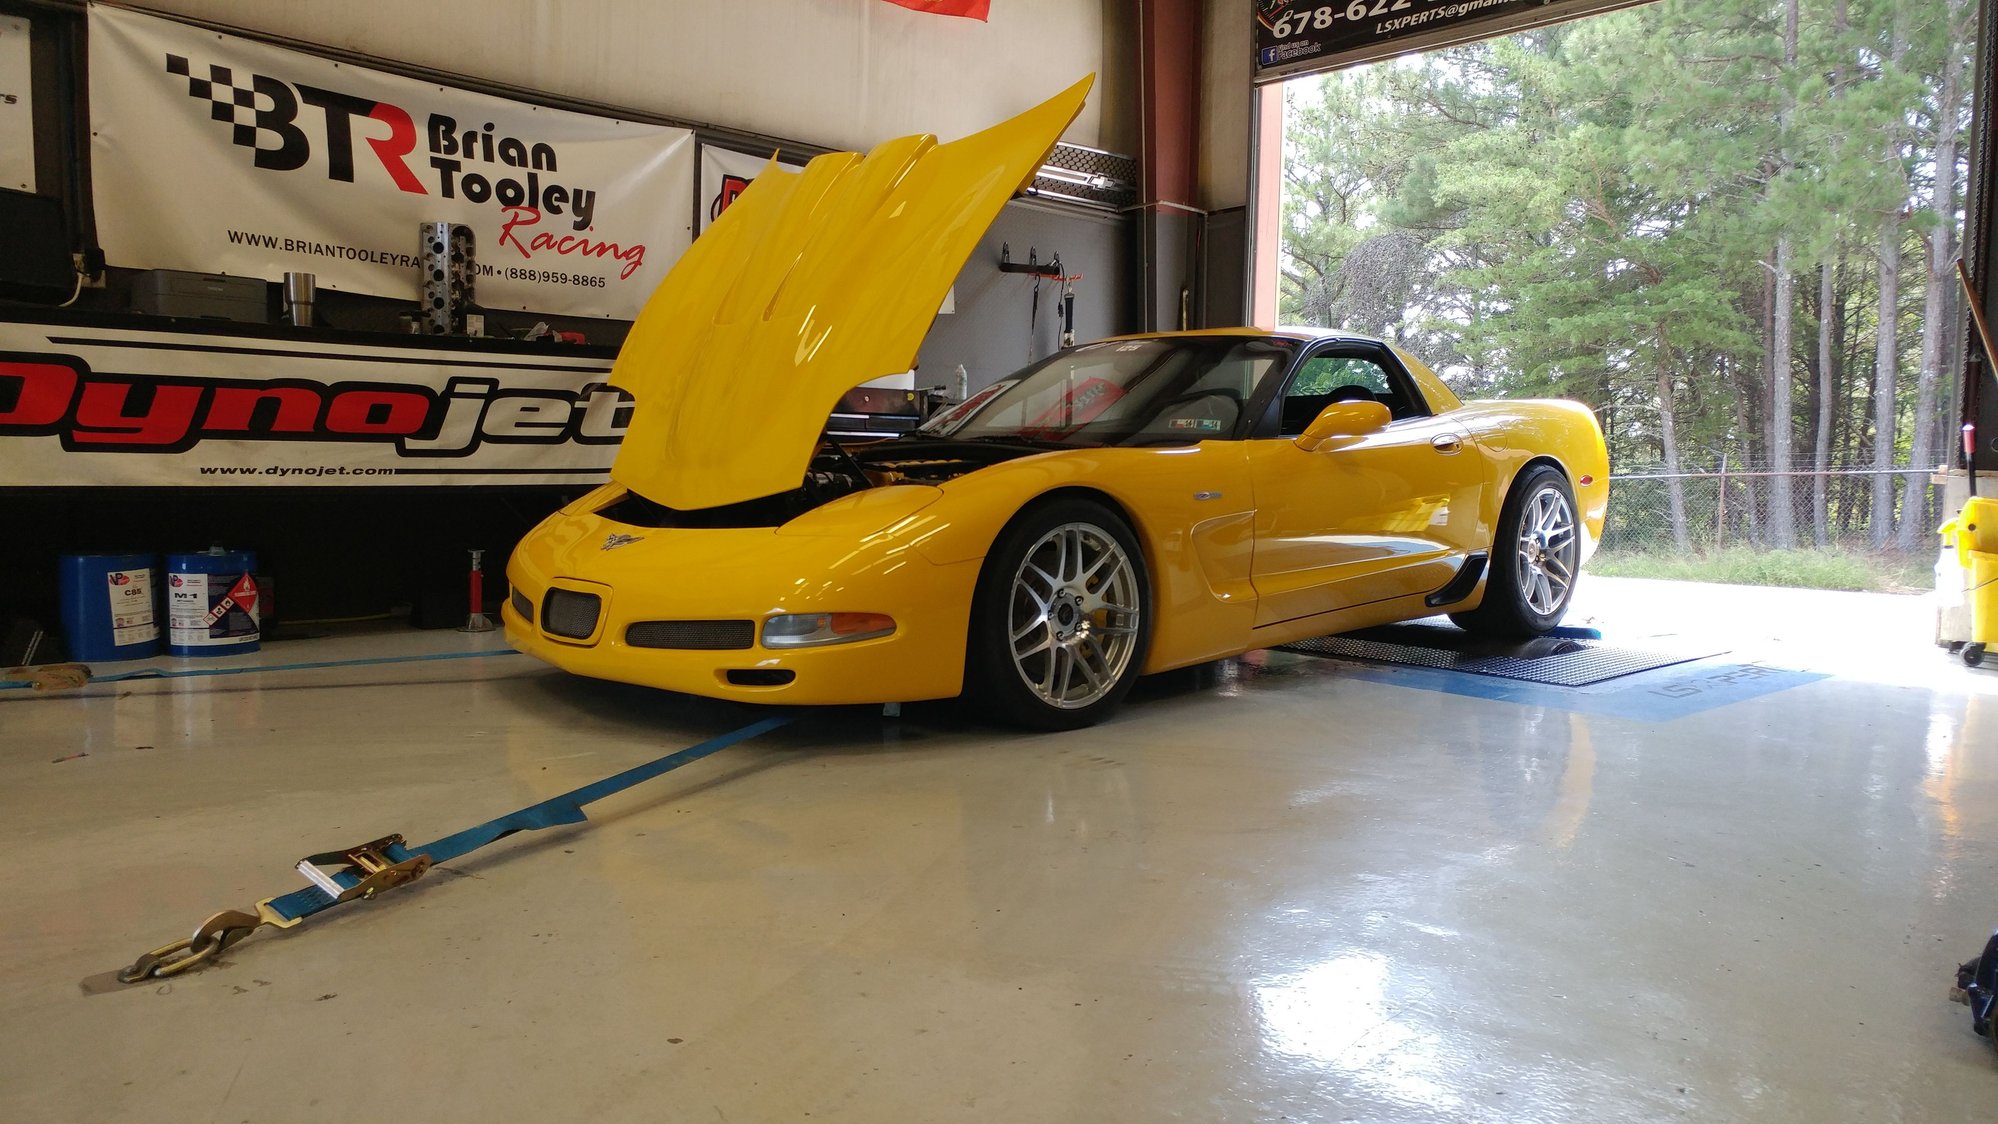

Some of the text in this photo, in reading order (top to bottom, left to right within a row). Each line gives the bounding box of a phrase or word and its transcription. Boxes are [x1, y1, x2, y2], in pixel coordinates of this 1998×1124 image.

[252, 74, 428, 195] BTR
[428, 113, 557, 172] Brian
[430, 156, 596, 231] Tooley
[499, 206, 646, 280] Racing
[504, 267, 605, 288] (888)959-8865
[0, 352, 635, 456] Dynojet
[200, 466, 395, 477] www.dynojet.com
